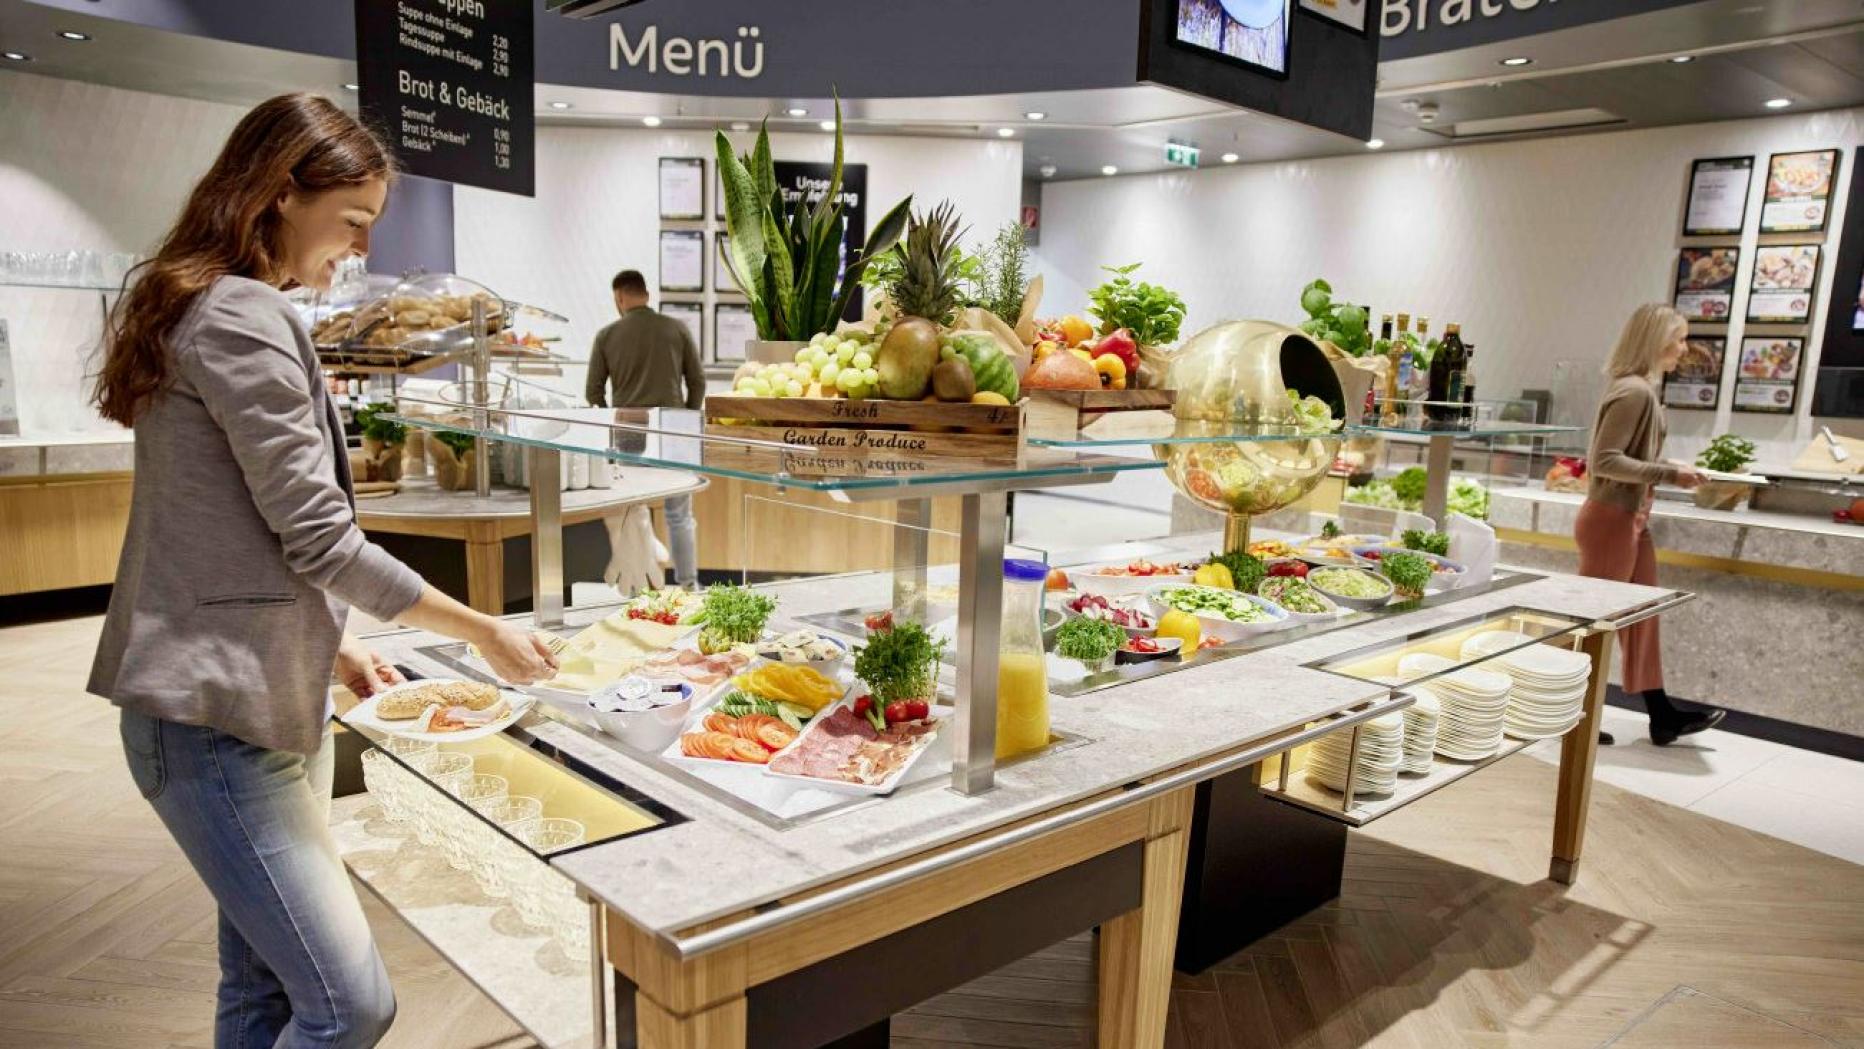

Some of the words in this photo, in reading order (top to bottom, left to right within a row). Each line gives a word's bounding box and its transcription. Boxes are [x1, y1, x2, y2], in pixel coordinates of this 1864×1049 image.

[398, 1, 424, 21] Suppe
[424, 12, 444, 28] ohne
[445, 18, 474, 39] Einlage
[438, 0, 484, 19] ppen
[399, 17, 445, 42] Tagessuppe
[399, 32, 441, 56] Rindsuppe
[441, 48, 455, 60] mit
[456, 50, 484, 71] Einlage
[609, 23, 765, 78] Menü
[398, 69, 434, 101] Brot
[439, 81, 451, 105] &
[456, 86, 510, 120] Gebäck
[402, 119, 420, 135] Brot
[832, 401, 878, 417] Fresh
[784, 427, 847, 448] Garden
[852, 430, 927, 450] Produce
